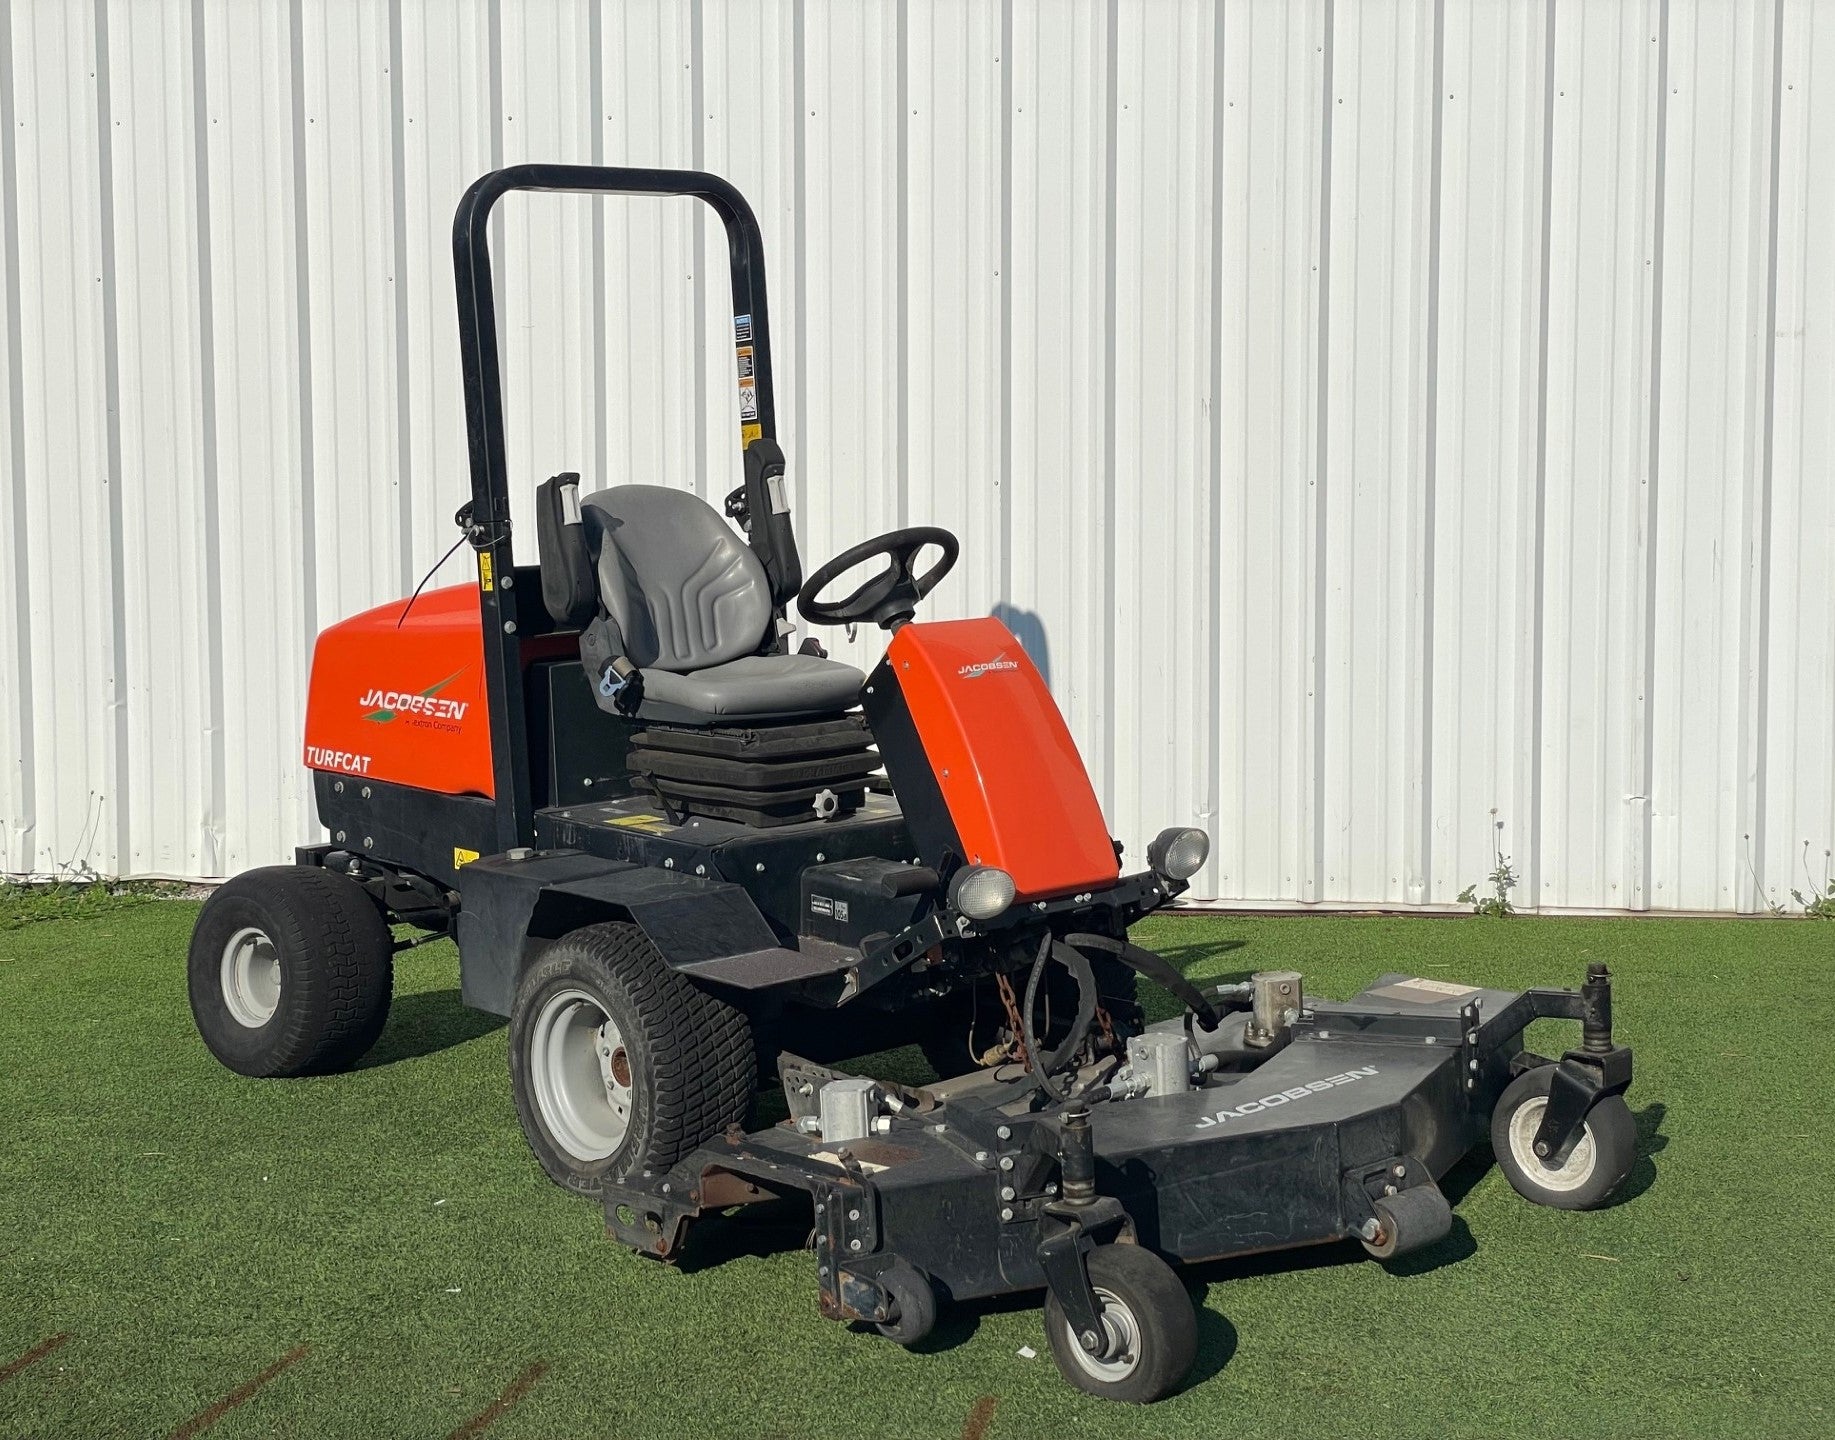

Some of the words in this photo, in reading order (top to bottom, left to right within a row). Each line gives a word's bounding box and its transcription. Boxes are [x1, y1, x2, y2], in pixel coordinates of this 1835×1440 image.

[958, 661, 1018, 674] JACOBSEN
[360, 689, 465, 720] JACOBSEN
[307, 746, 372, 773] TURFCAT
[1195, 1065, 1379, 1128] JACOBSEN
